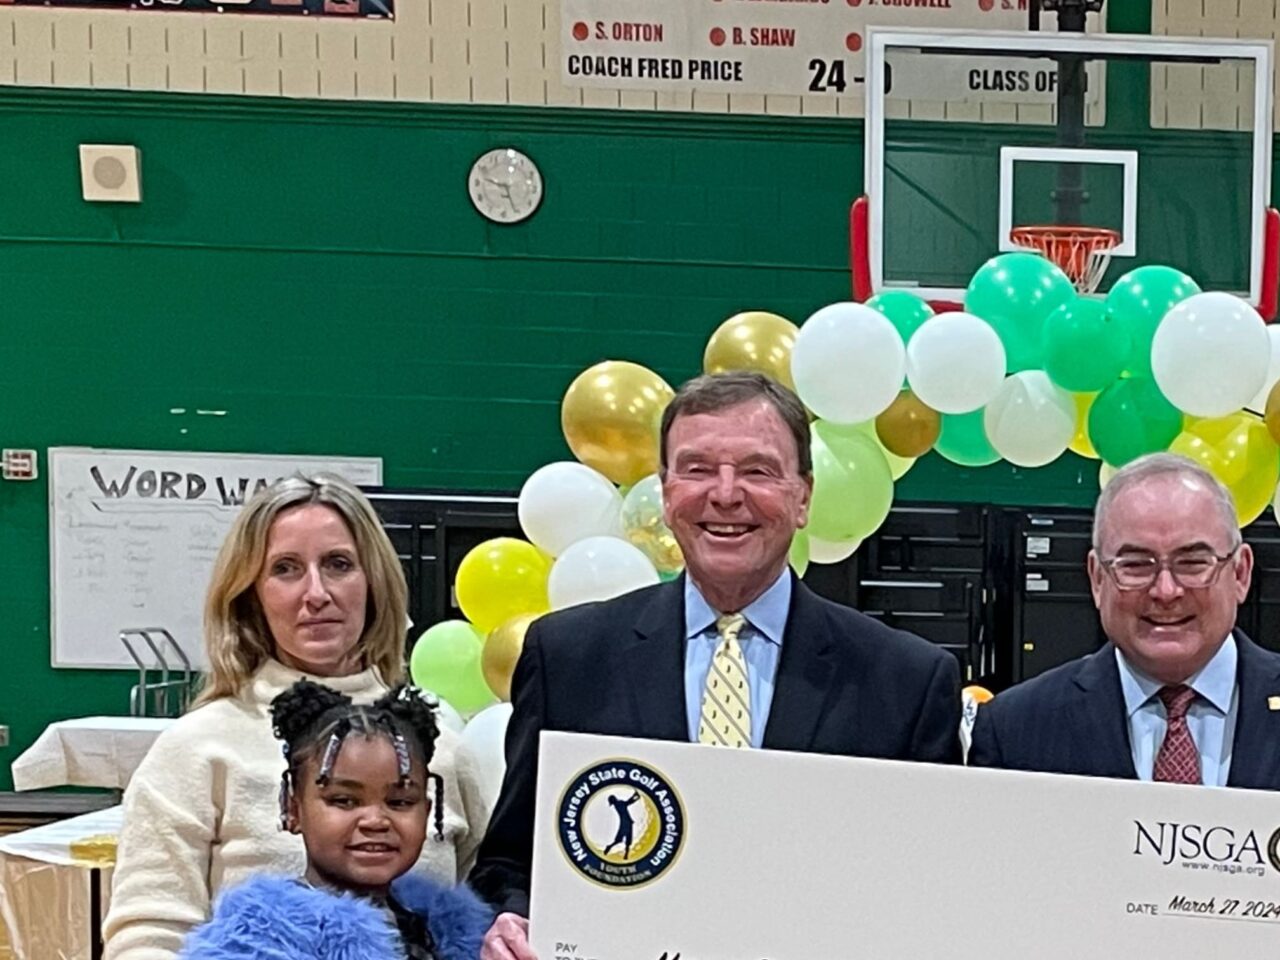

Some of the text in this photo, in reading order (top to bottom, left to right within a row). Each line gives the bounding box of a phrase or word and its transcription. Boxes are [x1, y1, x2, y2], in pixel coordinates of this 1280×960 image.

[595, 21, 663, 42] S. ORTON
[732, 27, 796, 47] B. SHAW
[568, 54, 743, 81] COACH FRED PRICE
[968, 68, 1058, 92] CLASS OF
[90, 465, 207, 500] WORD
[563, 767, 678, 866] New Jersey State Golf Association
[1132, 820, 1266, 866] NJSGA
[1126, 903, 1159, 915] DATE
[1168, 895, 1215, 914] March
[555, 942, 577, 953] PAY
